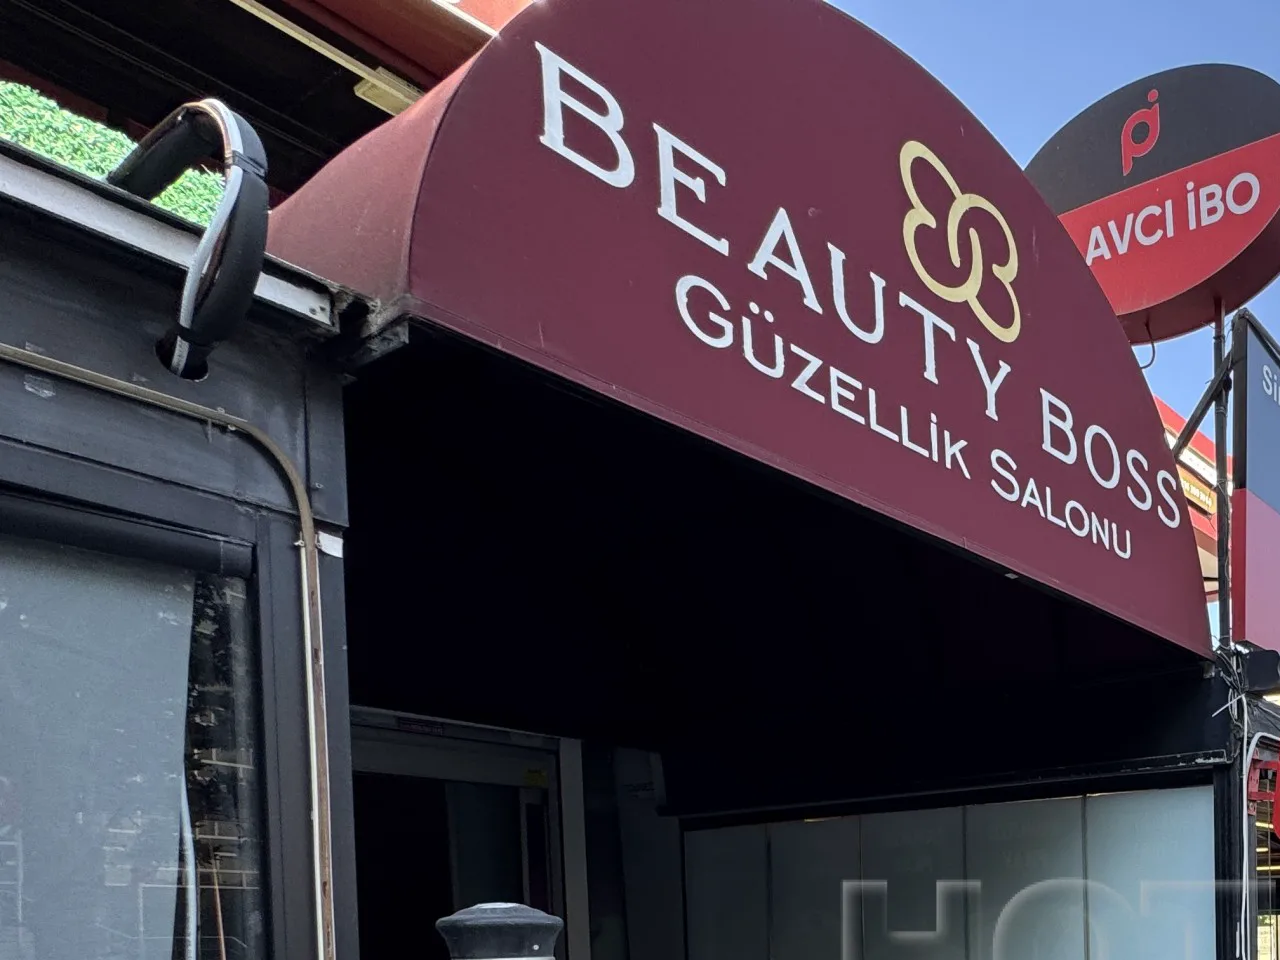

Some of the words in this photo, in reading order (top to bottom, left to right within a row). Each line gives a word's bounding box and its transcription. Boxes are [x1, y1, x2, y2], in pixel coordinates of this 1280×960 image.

[535, 41, 1011, 420] BEAUTY
[1039, 387, 1182, 529] BOSS
[1186, 172, 1260, 230] İBO
[675, 275, 970, 480] GÜZELLİK
[991, 451, 1132, 559] SALONU
